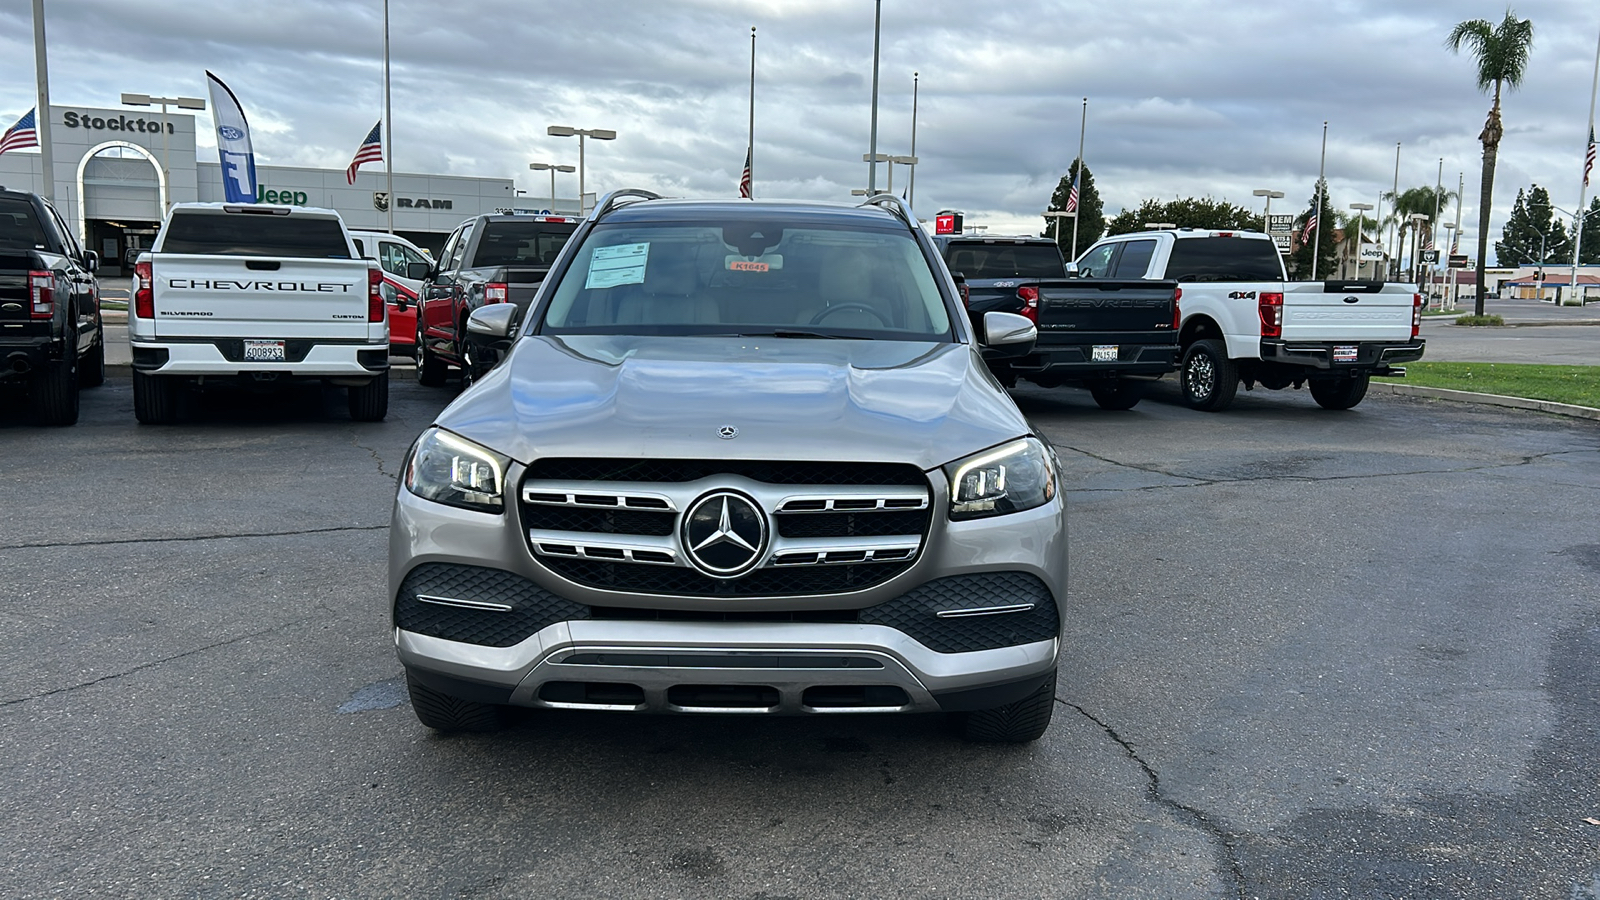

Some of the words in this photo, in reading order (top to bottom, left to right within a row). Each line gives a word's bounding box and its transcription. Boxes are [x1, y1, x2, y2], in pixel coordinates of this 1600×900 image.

[63, 111, 174, 135] Stockton
[256, 184, 308, 206] Jeep
[397, 198, 453, 210] RAM
[1271, 216, 1292, 224] OEM
[1361, 249, 1383, 258] Jeep
[169, 279, 354, 293] CHEVROLET
[1049, 298, 1168, 308] CHEVROLET
[1292, 312, 1354, 320] SUPER
[1359, 312, 1403, 320] DUTY
